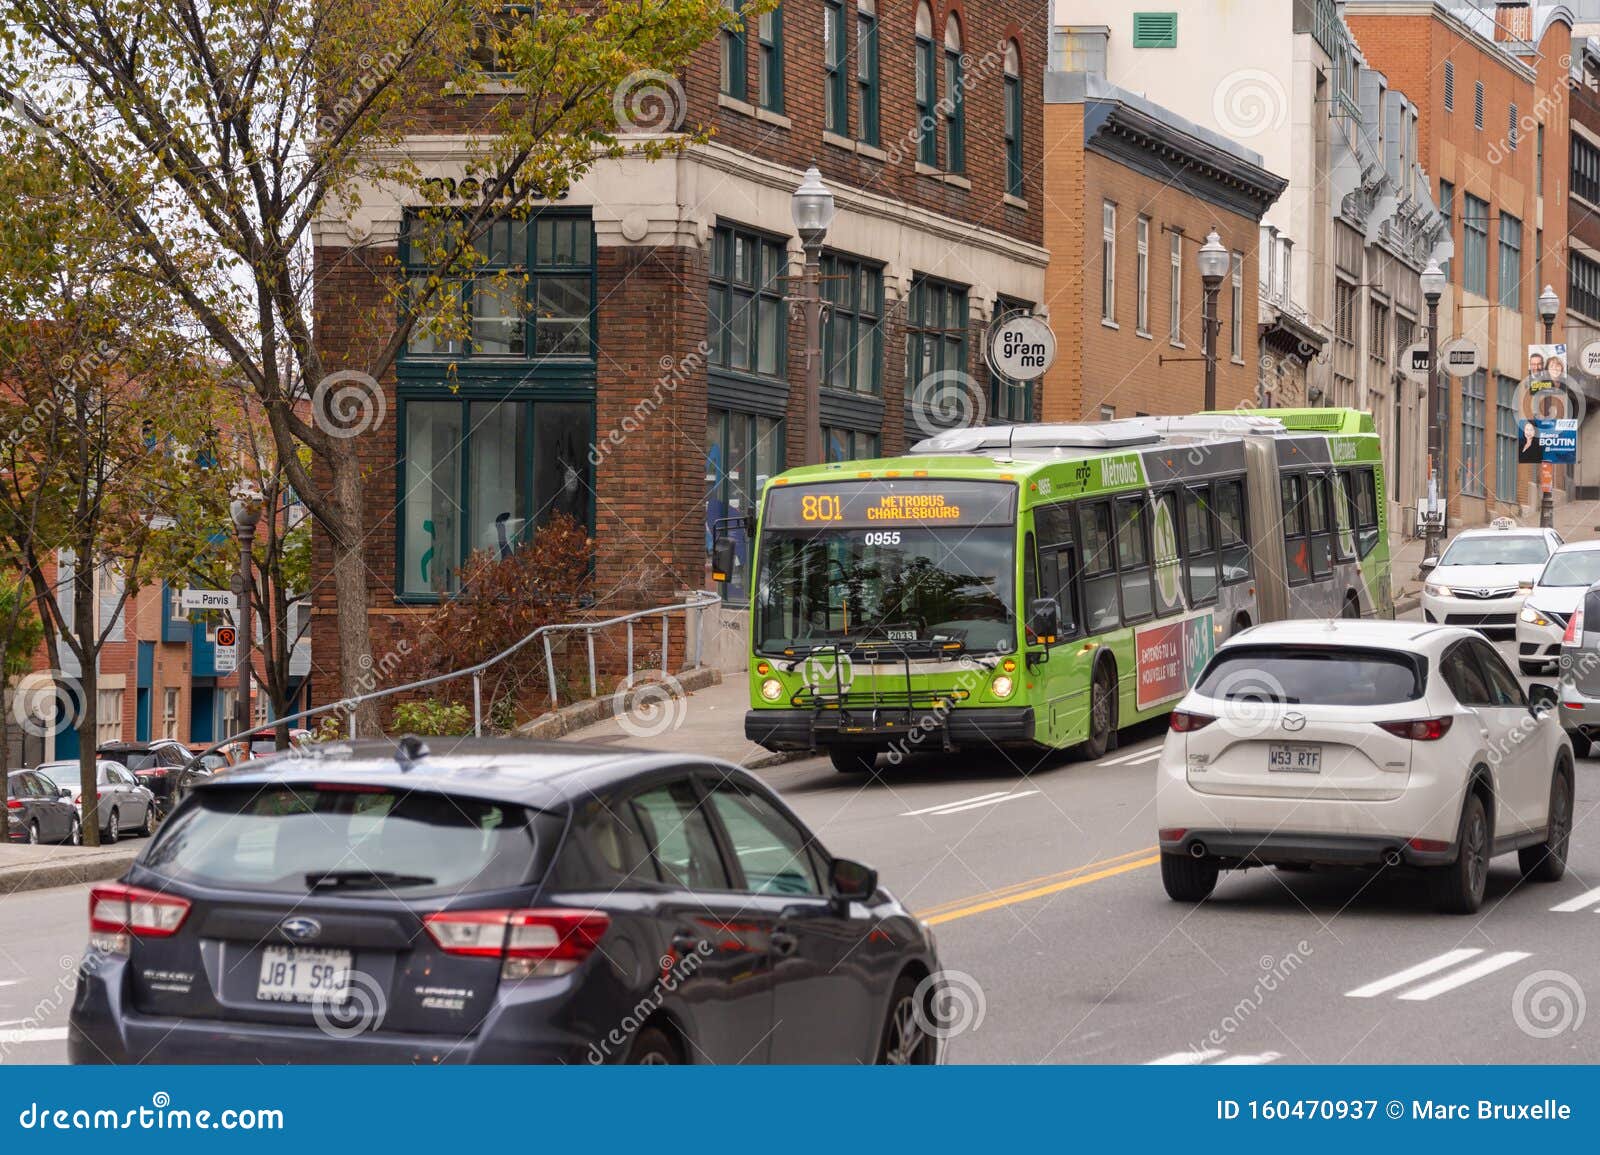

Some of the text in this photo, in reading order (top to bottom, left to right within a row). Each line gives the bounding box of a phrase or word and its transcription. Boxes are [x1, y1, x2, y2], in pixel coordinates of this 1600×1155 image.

[1004, 332, 1023, 343] en
[1004, 344, 1045, 358] gram
[1021, 356, 1045, 367] me
[1413, 360, 1429, 369] VU
[1539, 438, 1575, 446] BOUTIN
[1076, 467, 1091, 480] RTC
[1101, 455, 1138, 487] Métrobus
[801, 495, 843, 521] 801
[881, 495, 945, 508] METROBUS
[867, 506, 960, 520] CHARLESBOURG
[865, 532, 900, 546] 0955
[202, 594, 229, 605] Parvis
[890, 631, 914, 640] 2033
[1169, 642, 1177, 656] LA
[1271, 752, 1319, 766] W53 RTF
[261, 962, 349, 990] J81 SBJ
